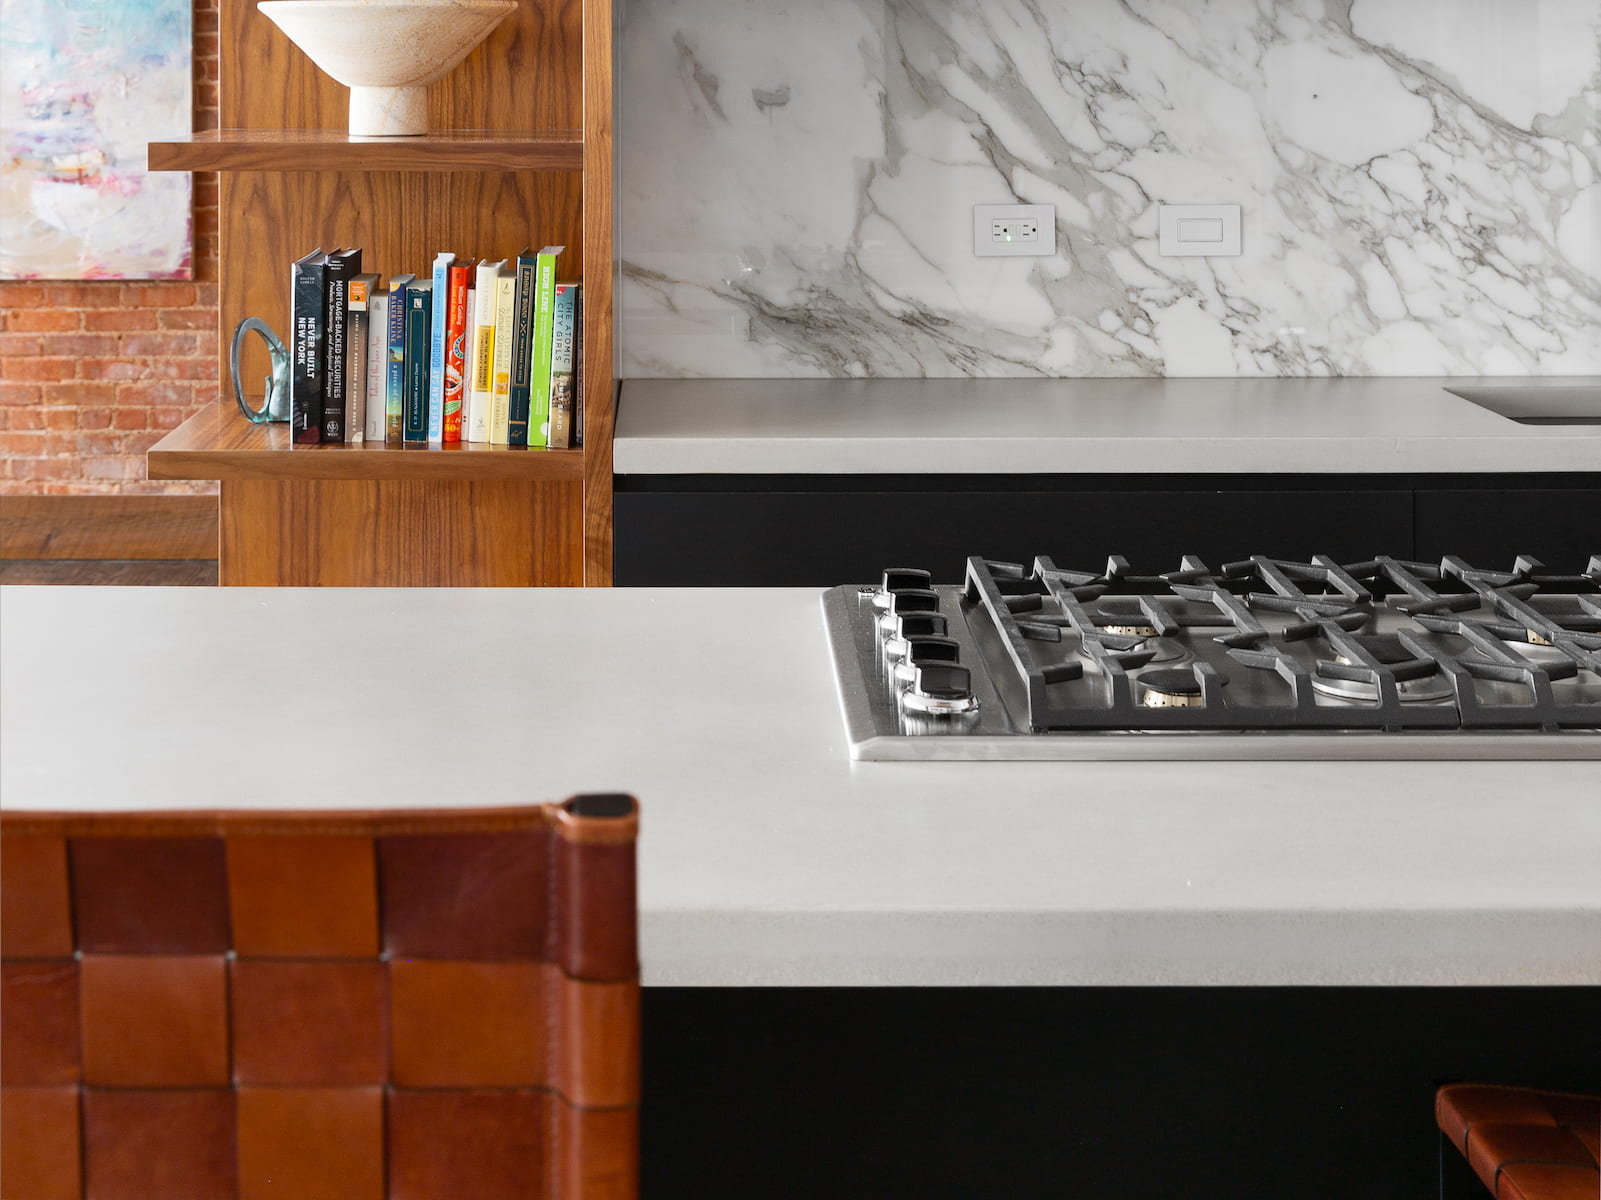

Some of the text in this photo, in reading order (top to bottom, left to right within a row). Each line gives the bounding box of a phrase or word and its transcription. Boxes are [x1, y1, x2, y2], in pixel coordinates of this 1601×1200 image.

[542, 266, 551, 290] HIGH
[334, 280, 344, 354] MORTGAGE-BACKED
[456, 304, 464, 326] Golding
[540, 291, 550, 313] LINE
[297, 317, 306, 365] NEW YORK
[555, 302, 564, 361] CITY GIRLS
[563, 300, 573, 365] THE ATOMIC
[306, 317, 316, 379] NEVER BUILT
[432, 332, 441, 368] GOODBYE
[333, 355, 342, 399] SECURITIES
[432, 369, 440, 385] SAY
[431, 386, 440, 403] CAN
[430, 405, 440, 432] NEVER
[556, 403, 564, 430] BEARD
